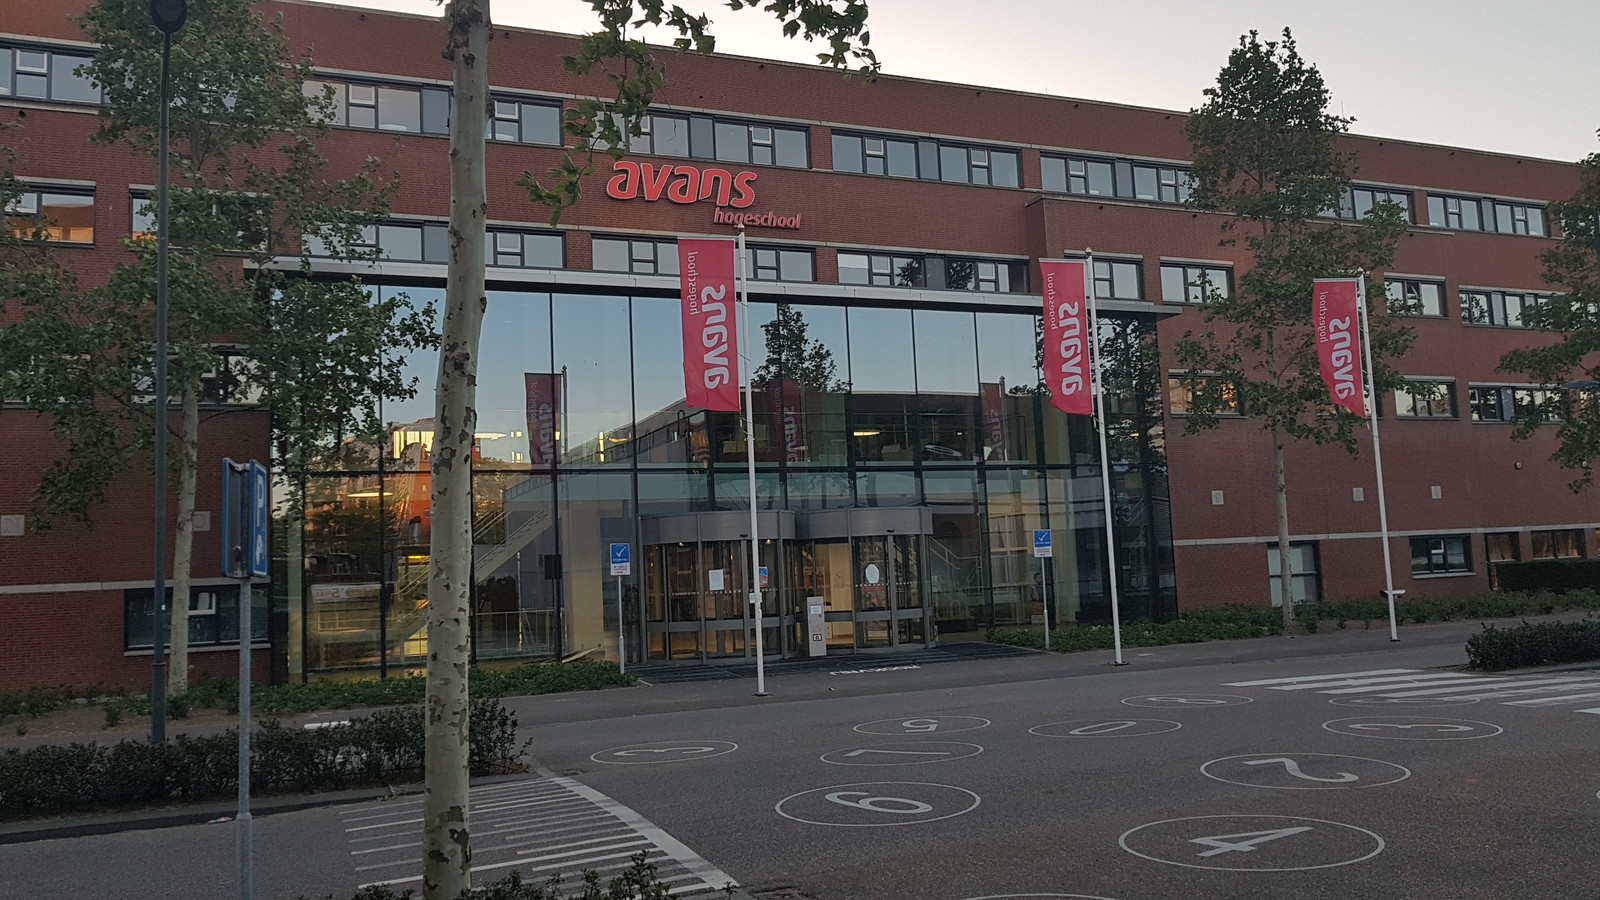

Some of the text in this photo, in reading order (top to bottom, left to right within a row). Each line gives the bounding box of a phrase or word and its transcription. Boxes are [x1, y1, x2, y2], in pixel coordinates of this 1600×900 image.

[606, 161, 758, 208] avans
[713, 207, 801, 230] hogeschool
[901, 718, 939, 733] 5
[1243, 757, 1360, 783] 2
[1188, 826, 1314, 857] 4
